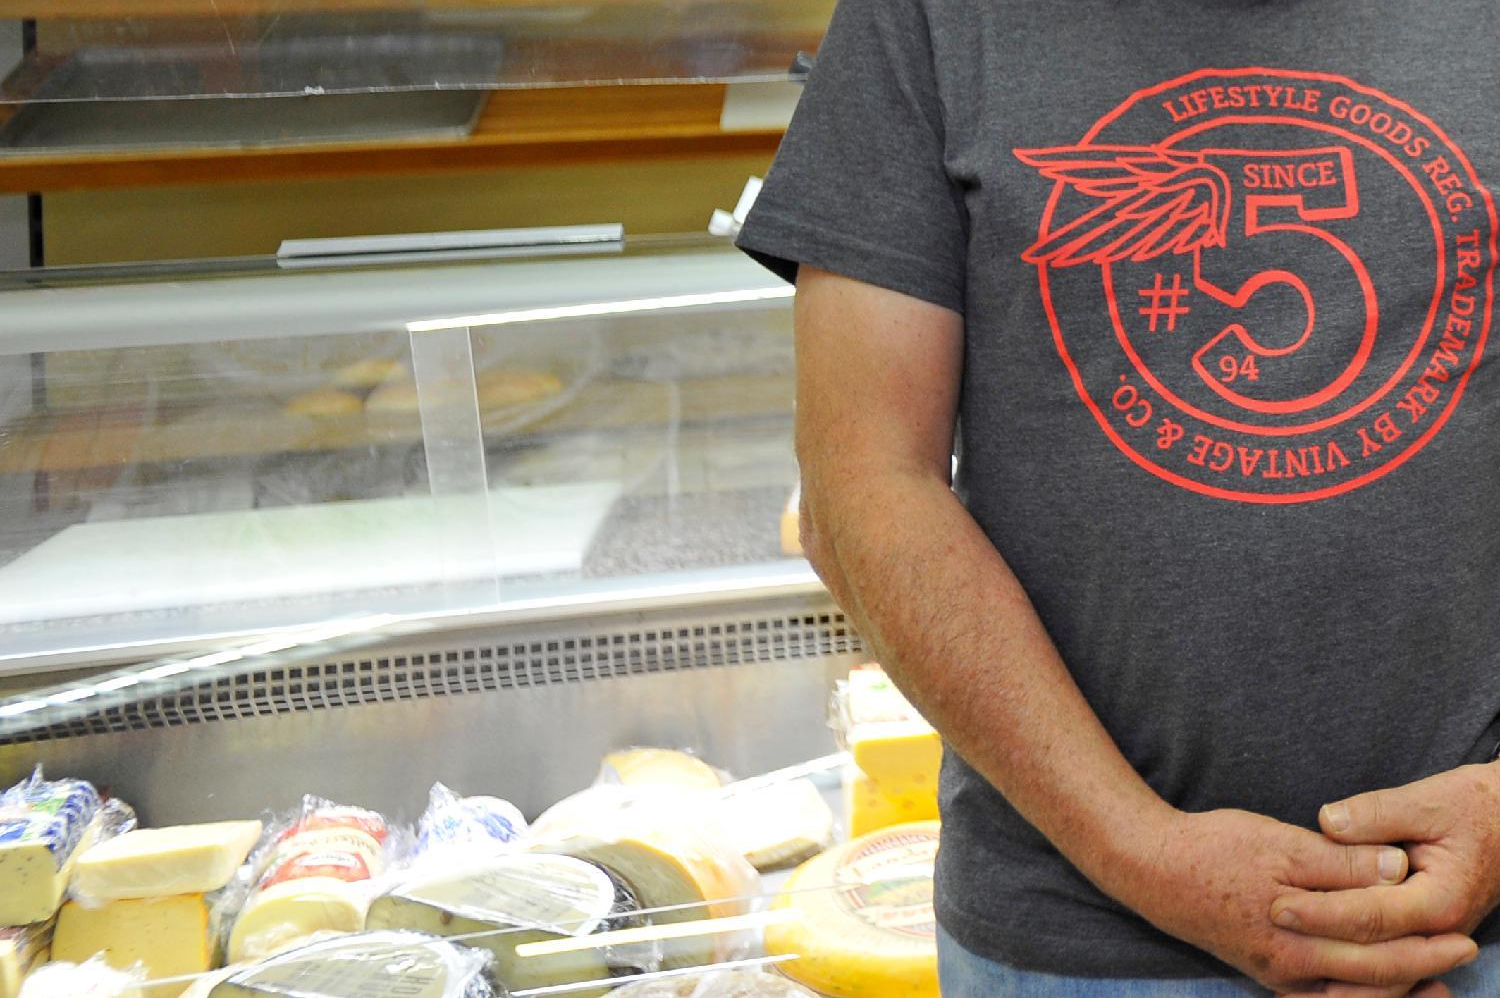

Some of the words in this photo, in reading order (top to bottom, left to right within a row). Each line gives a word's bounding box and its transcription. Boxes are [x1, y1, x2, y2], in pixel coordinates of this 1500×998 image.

[1163, 85, 1322, 122] LIFESTYLE
[1329, 96, 1430, 158] GOODS
[1244, 161, 1337, 189] SINCE
[1421, 156, 1472, 222] REG.
[1397, 229, 1481, 423] TRADEMARK
[1219, 355, 1260, 382] 94
[1112, 374, 1153, 427] CO.
[1157, 418, 1184, 449] &
[1187, 434, 1350, 479] VINTAGE
[1356, 411, 1403, 458] BY
